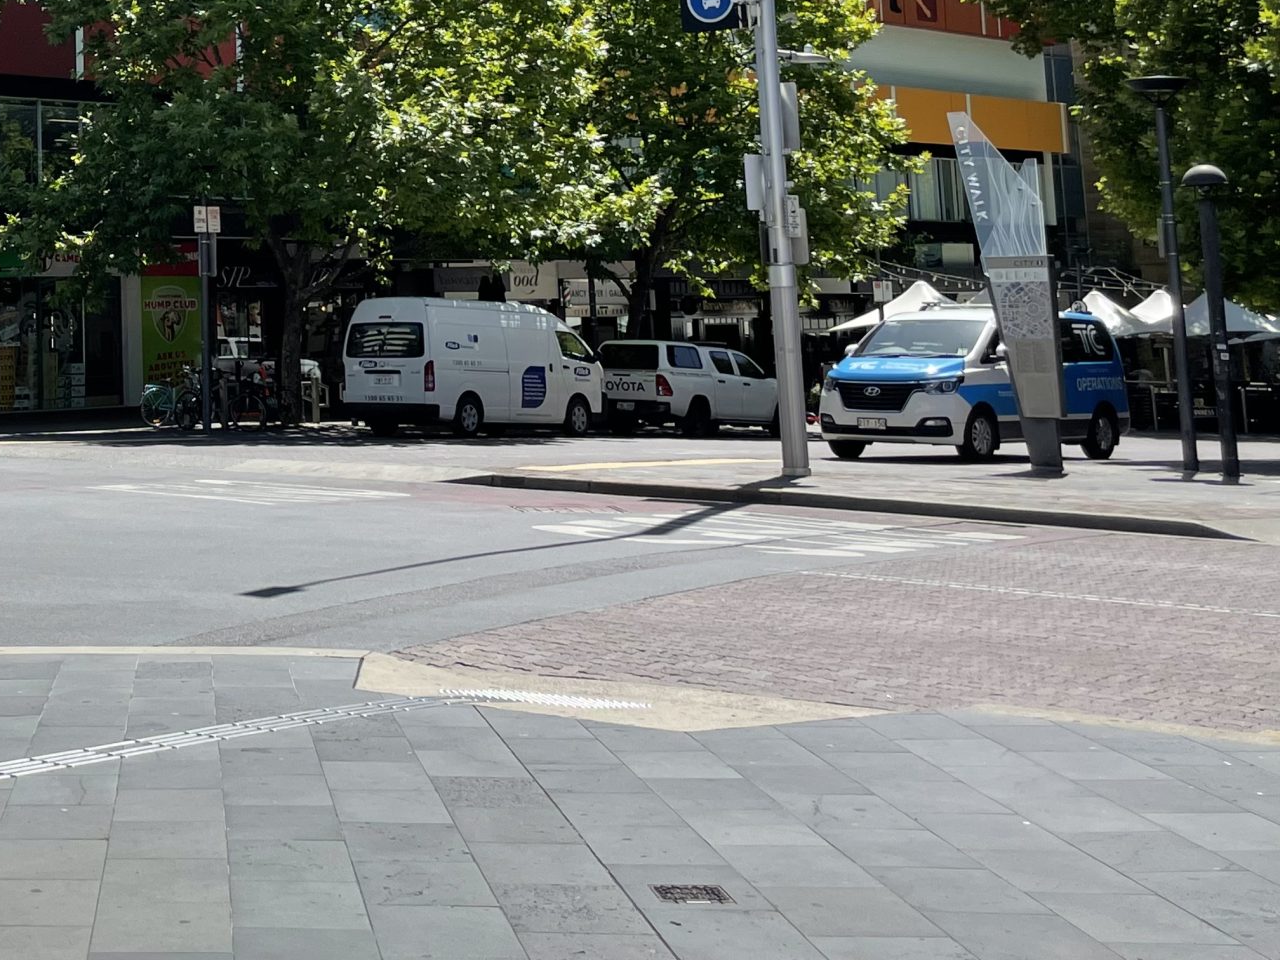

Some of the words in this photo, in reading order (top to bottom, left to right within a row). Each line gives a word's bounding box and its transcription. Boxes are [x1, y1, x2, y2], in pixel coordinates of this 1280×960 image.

[55, 253, 81, 263] CAME
[571, 289, 587, 297] ANCY
[144, 300, 171, 309] HUMP
[173, 300, 196, 309] CLUB
[605, 380, 646, 392] OYOTA
[1076, 376, 1123, 392] OPERATIONS
